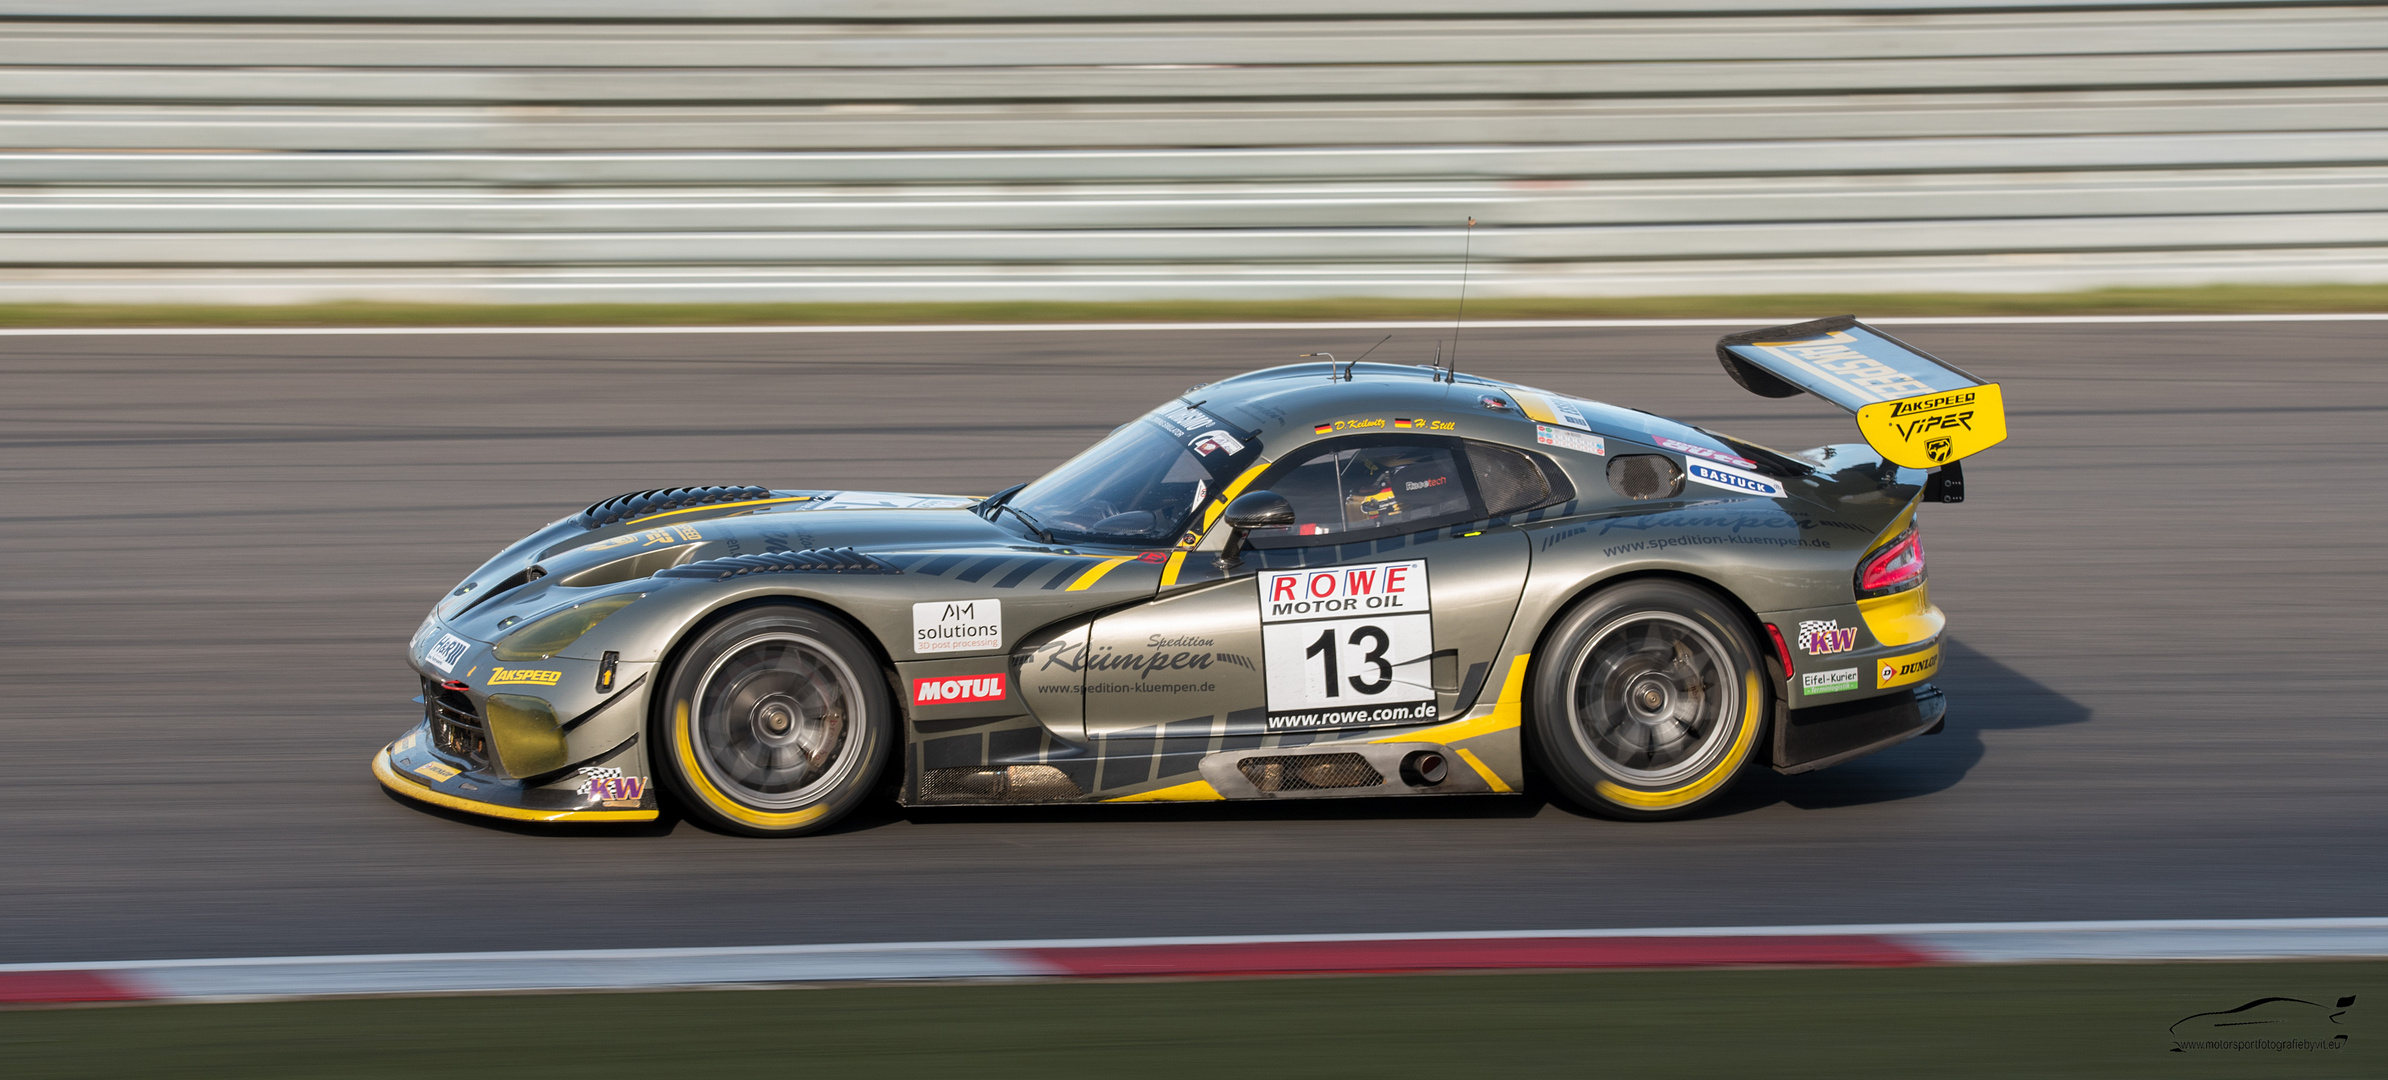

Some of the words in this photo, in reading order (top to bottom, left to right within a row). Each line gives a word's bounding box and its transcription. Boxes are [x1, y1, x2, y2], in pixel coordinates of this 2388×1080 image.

[1889, 392, 1976, 418] ZAKSPEED
[1430, 420, 1456, 431] Still
[1896, 411, 1975, 442] VIPER
[1700, 467, 1766, 492] BASTUCK
[1603, 534, 1831, 557] www.spedition-kluempen.de
[1270, 565, 1409, 602] ROWE
[1272, 598, 1357, 616] MOTOR
[1366, 594, 1403, 608] OIL
[918, 623, 998, 640] solutions
[1147, 633, 1214, 650] Spedition
[1809, 627, 1857, 655] KW
[918, 641, 930, 650] 3D
[932, 640, 951, 651] post
[953, 638, 998, 650] processing
[1038, 640, 1214, 680] Klümpen
[1306, 625, 1393, 698] 13
[1899, 654, 1938, 676] DUNLOP
[487, 667, 562, 686] ZAKSPEED
[1038, 681, 1216, 694] www.spedition-kluempen.de
[1804, 671, 1857, 686] Eifel-Kurier
[917, 677, 1002, 701] MOTUL
[1268, 702, 1437, 729] www.rowe.com.de
[587, 776, 648, 802] KW
